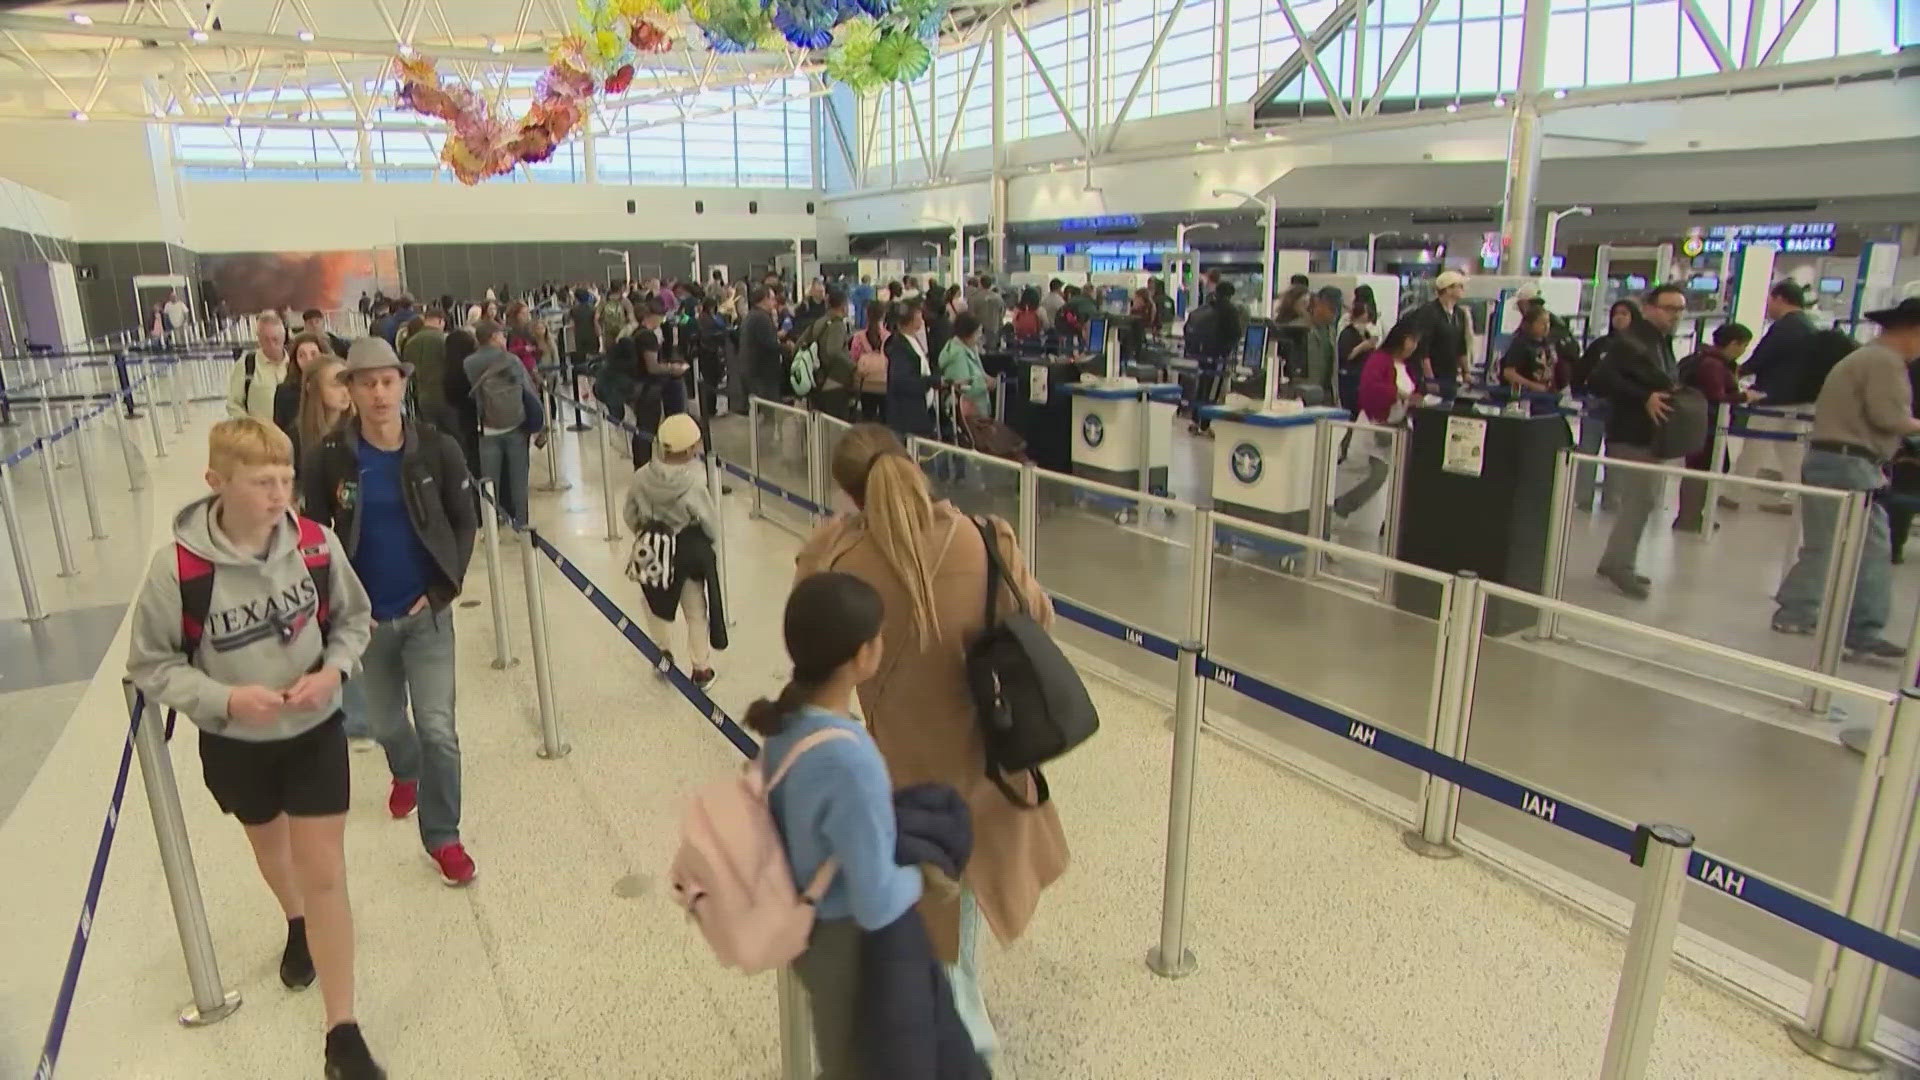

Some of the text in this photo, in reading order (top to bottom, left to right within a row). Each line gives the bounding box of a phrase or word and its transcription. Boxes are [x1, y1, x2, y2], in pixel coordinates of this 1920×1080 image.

[1786, 238, 1832, 251] BAGELS
[206, 577, 316, 636] TEXANS
[1126, 627, 1143, 645] IAH
[1214, 665, 1236, 688] IAH
[1349, 721, 1377, 746] IAH
[1522, 791, 1556, 821] IAH
[1701, 859, 1745, 896] IAH
